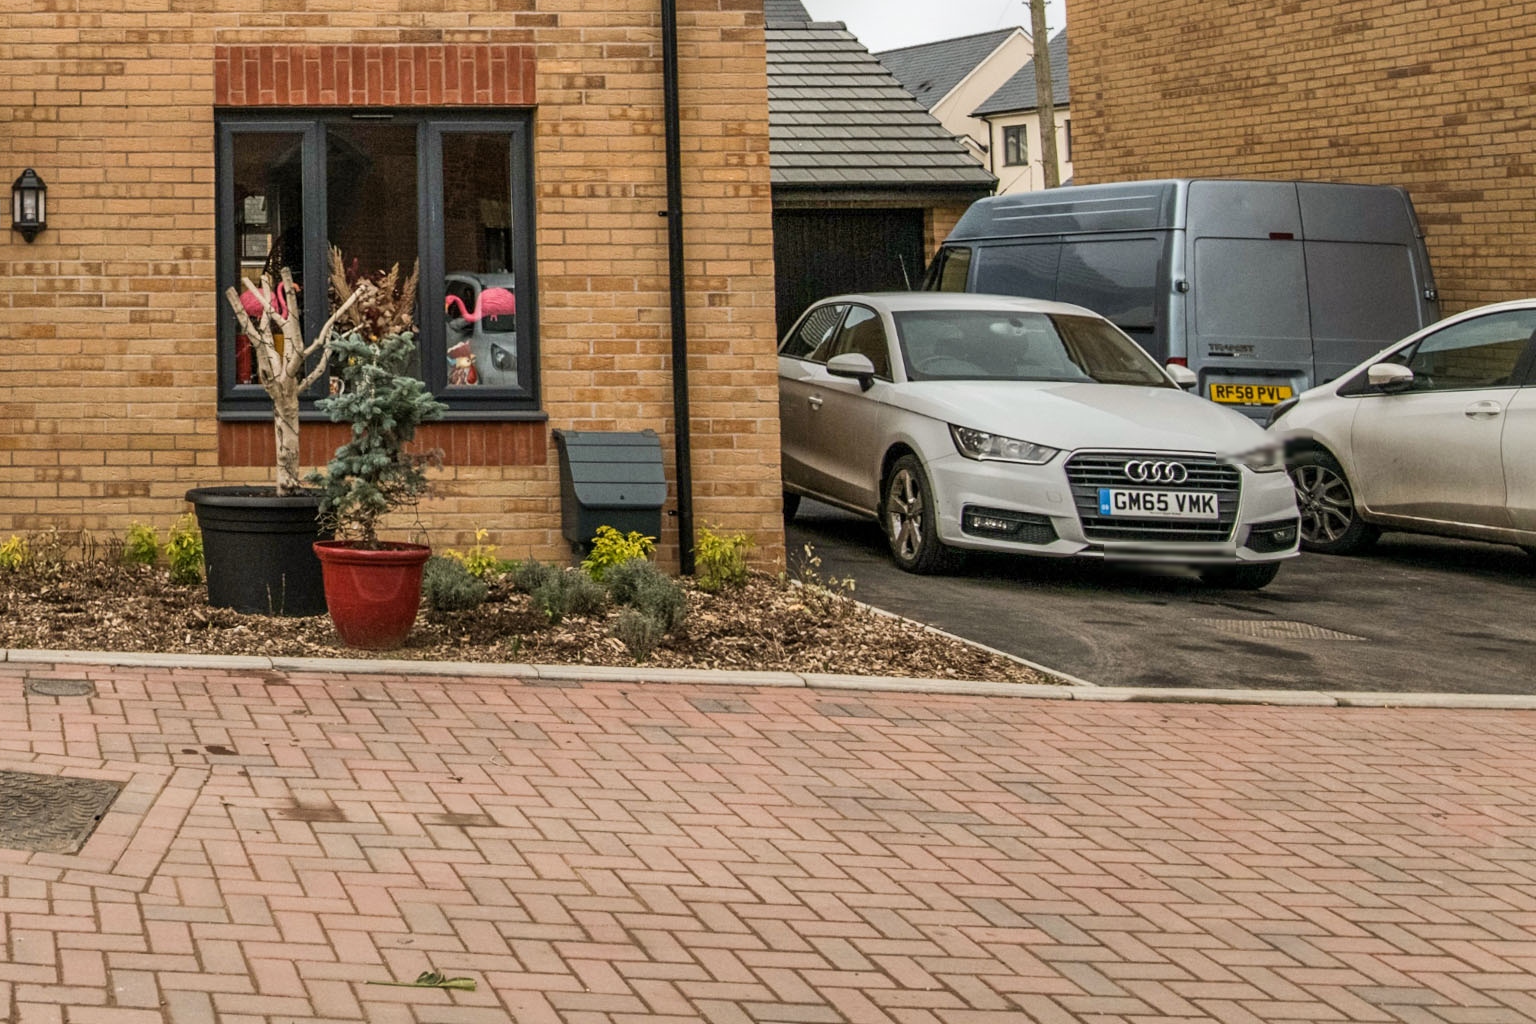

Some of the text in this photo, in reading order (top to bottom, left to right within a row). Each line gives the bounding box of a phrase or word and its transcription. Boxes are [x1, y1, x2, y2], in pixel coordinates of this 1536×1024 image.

[1216, 385, 1286, 401] RF58 PVL
[1114, 492, 1215, 513] GM65 VMK
